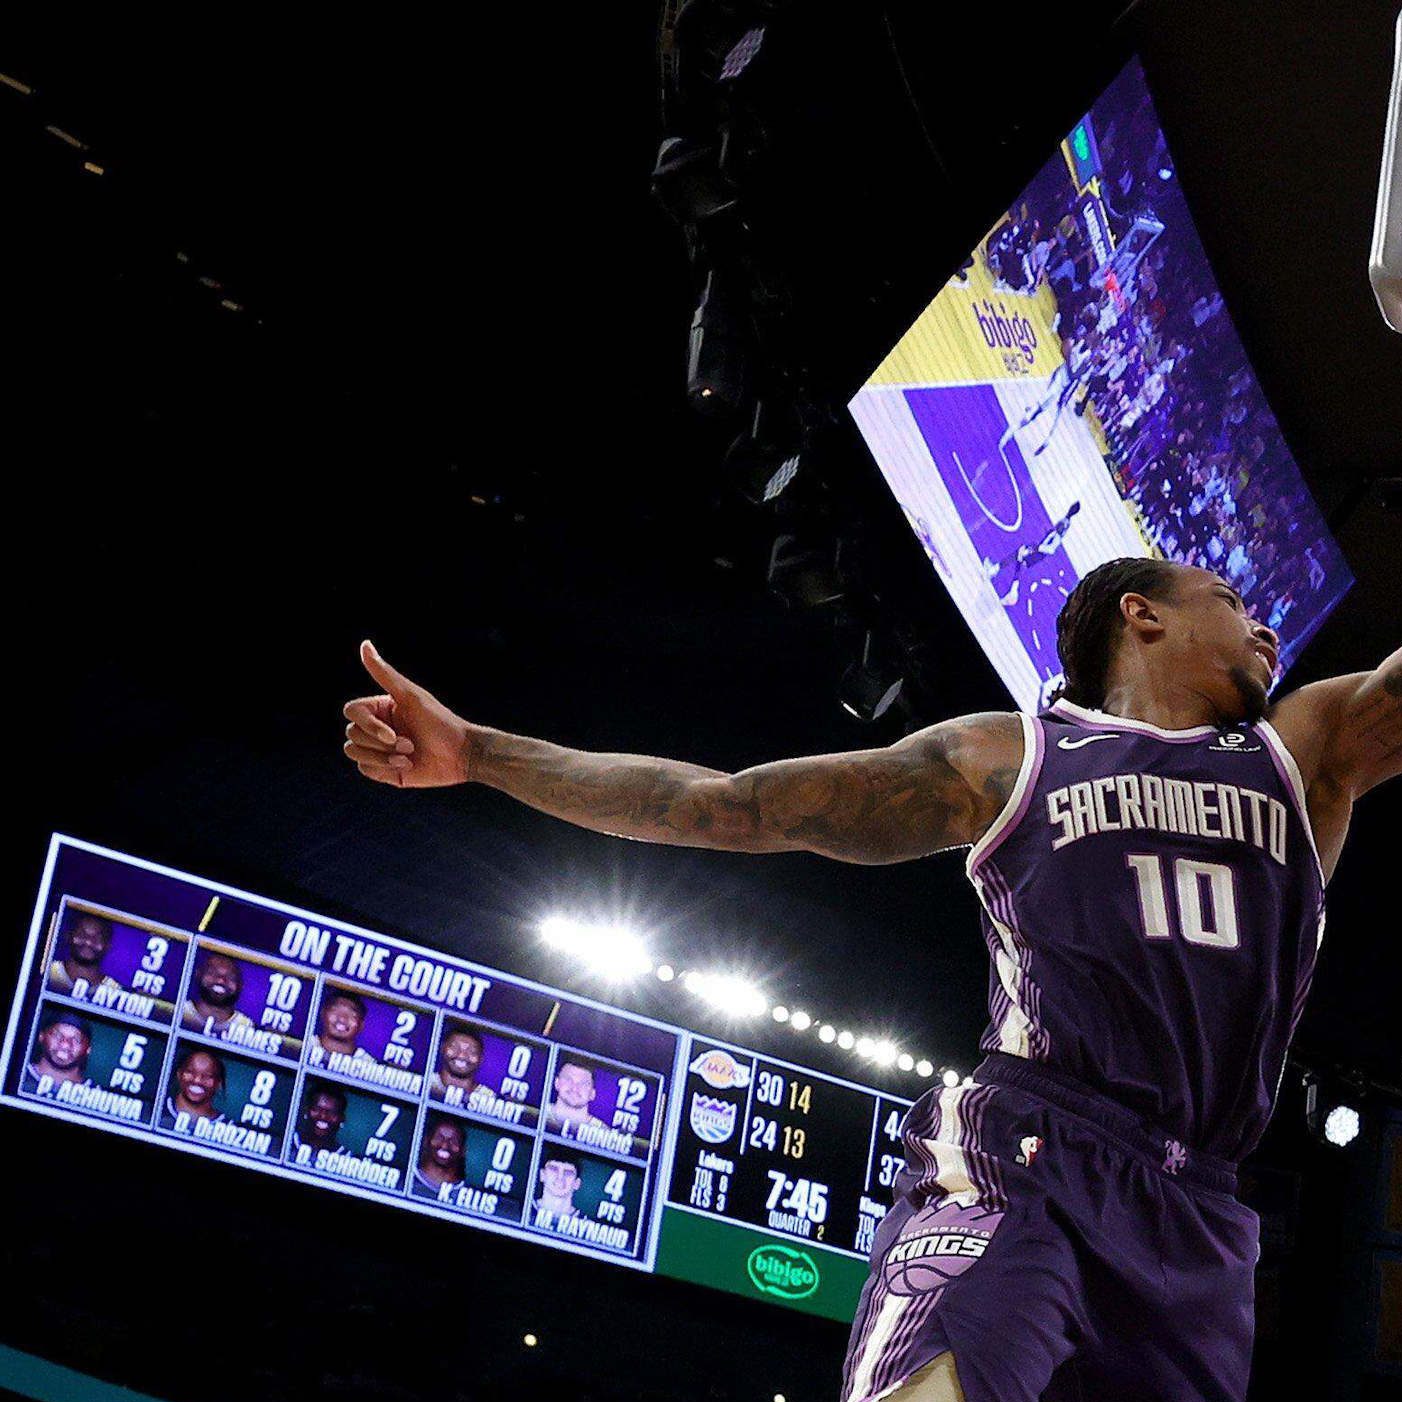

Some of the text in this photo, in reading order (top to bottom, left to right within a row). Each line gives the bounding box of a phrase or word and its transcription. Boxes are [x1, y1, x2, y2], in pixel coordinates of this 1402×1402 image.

[972, 299, 1038, 364] bibigo
[1047, 773, 1287, 865] SACRAMENTO
[1125, 853, 1242, 949] 10
[141, 937, 168, 971] 3
[280, 921, 490, 1013] ON THE COURT
[72, 978, 154, 1019] D. AYTON
[132, 970, 165, 995] PTS
[266, 973, 301, 1011] 10
[203, 1016, 282, 1054] L. JAMES
[260, 1008, 293, 1032] PTS
[394, 1012, 416, 1045] 2
[120, 1033, 147, 1069] 5
[384, 1043, 414, 1068] PTS
[508, 1046, 531, 1078] 0
[37, 1075, 54, 1098] P.
[110, 1068, 144, 1093] PTS
[250, 1070, 276, 1105] 8
[310, 1047, 424, 1096] R. HACHIMURA
[445, 1085, 525, 1124] M. SMART
[500, 1077, 529, 1101] PTS
[617, 1077, 646, 1112] 12
[757, 1072, 812, 1114] 30 14
[174, 1112, 191, 1135] D.
[241, 1103, 273, 1128] PTS
[376, 1104, 399, 1137] 7
[561, 1120, 574, 1139] L.
[612, 1110, 640, 1133] PTS
[295, 1144, 312, 1166] D.
[366, 1136, 396, 1161] PTS
[492, 1138, 515, 1170] 0
[750, 1116, 776, 1151] 24
[783, 1126, 805, 1159] 13
[878, 1155, 906, 1187] 37
[484, 1169, 514, 1193] PTS
[604, 1169, 627, 1202] 4
[766, 1170, 828, 1223] 7:45
[438, 1181, 498, 1215] K. ELLIS
[597, 1199, 625, 1223] PTS
[535, 1209, 629, 1249] M. RAYNAUD
[768, 1211, 811, 1237] QUARTER
[886, 1235, 989, 1264] KINGS
[755, 1255, 814, 1286] bibigo
